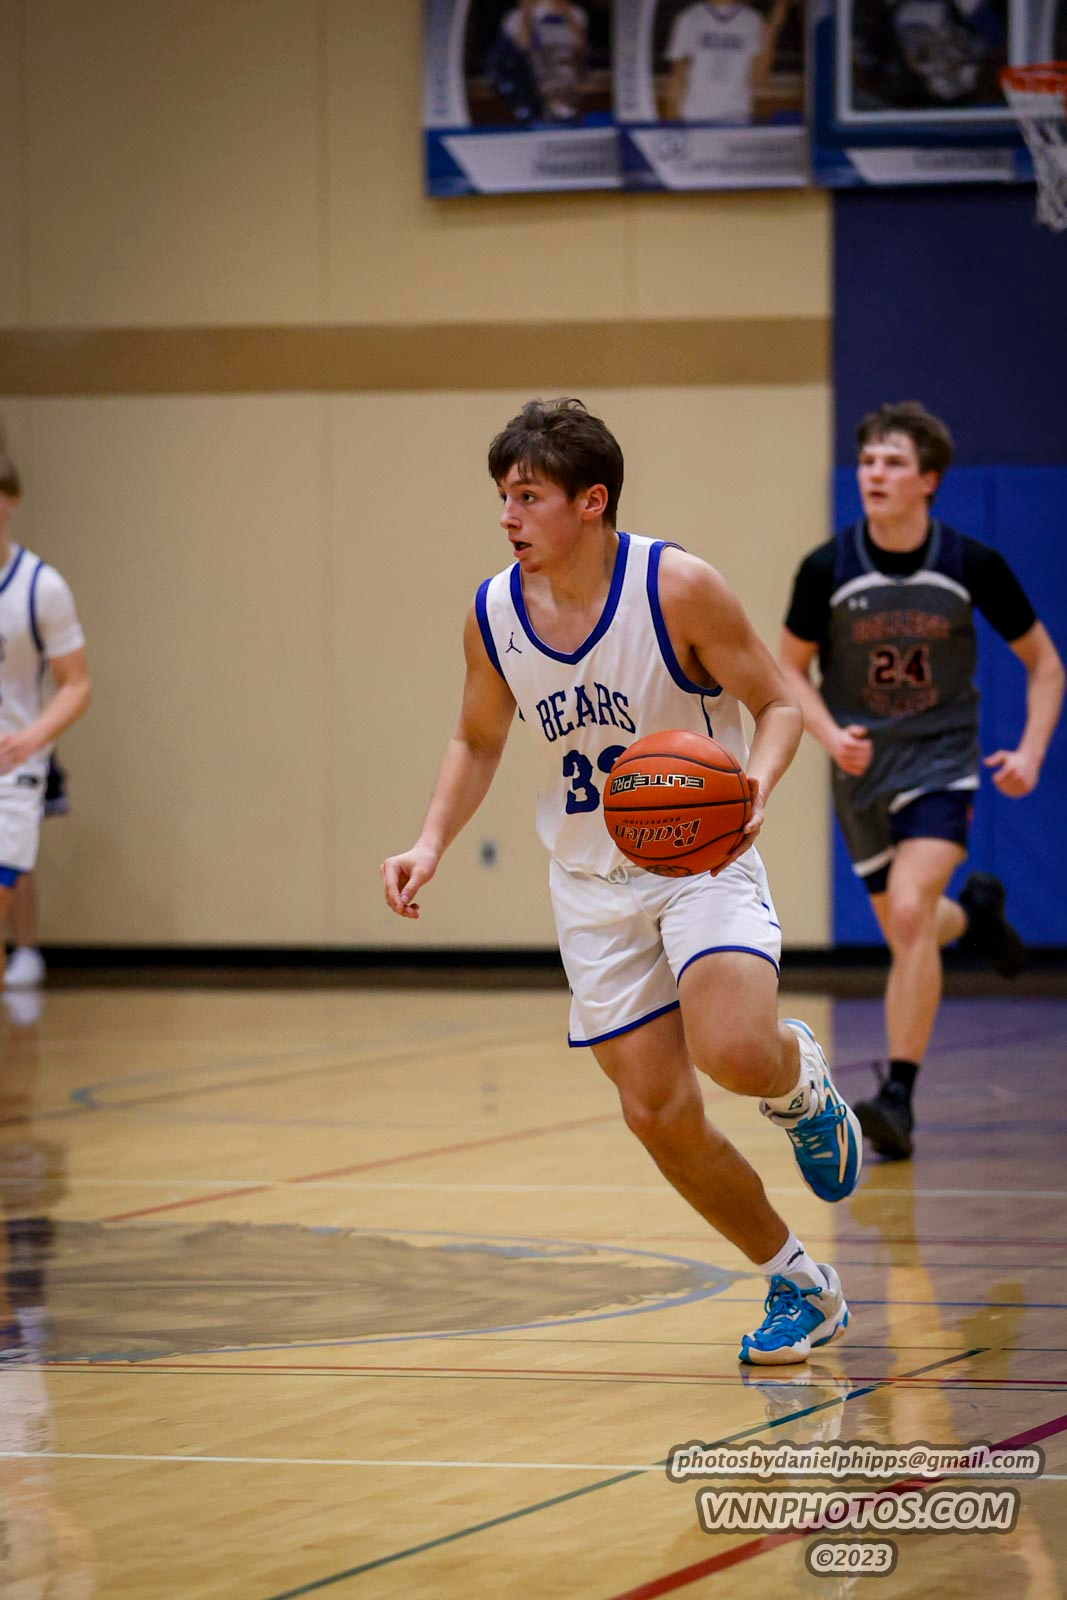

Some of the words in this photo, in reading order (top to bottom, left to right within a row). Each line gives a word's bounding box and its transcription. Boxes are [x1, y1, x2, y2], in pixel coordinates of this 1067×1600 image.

[868, 644, 932, 690] 24
[536, 682, 636, 742] BEARS
[614, 819, 701, 848] Baden
[623, 816, 681, 825] PERFECTION
